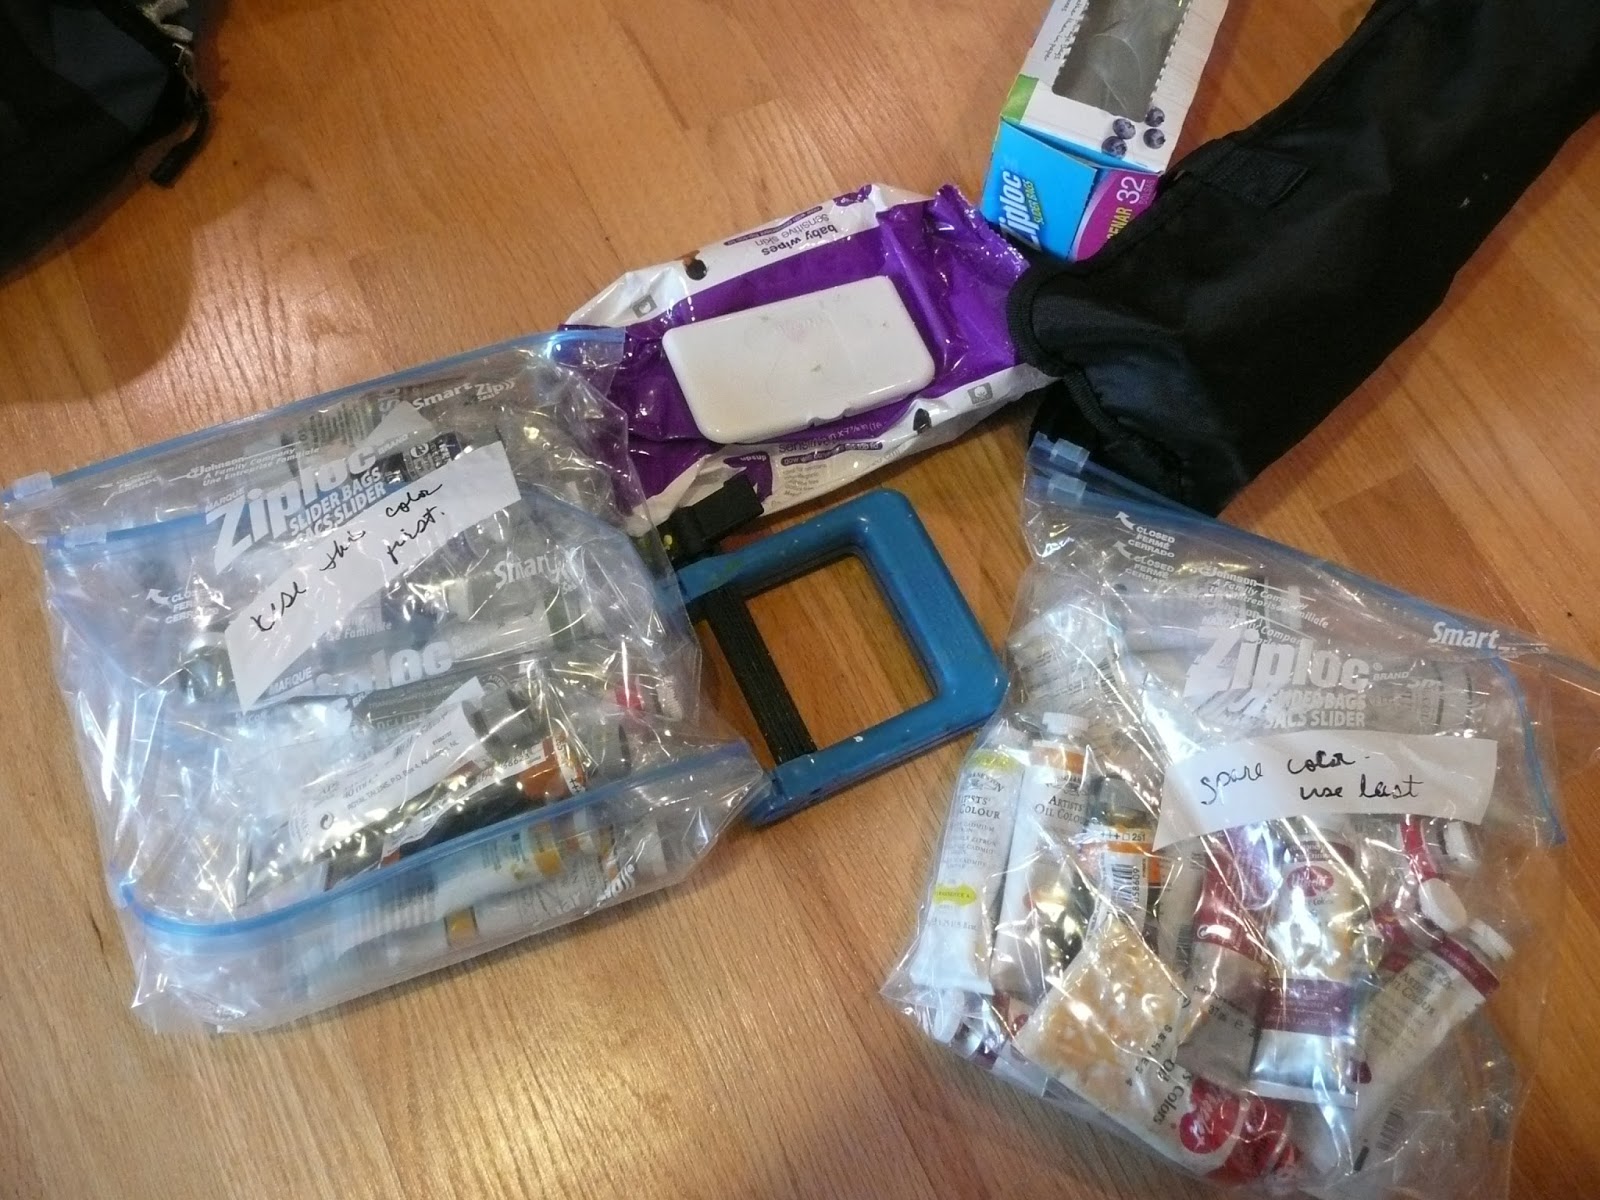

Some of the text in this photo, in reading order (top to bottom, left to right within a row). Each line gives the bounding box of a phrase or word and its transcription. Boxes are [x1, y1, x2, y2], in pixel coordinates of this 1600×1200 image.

[1022, 179, 1044, 225] SLIDER BAGS
[1117, 176, 1146, 204] 32
[780, 212, 829, 239] sensitive
[801, 222, 838, 245] baby
[755, 231, 782, 247] skin
[760, 233, 802, 257] wipes
[412, 381, 472, 411] Smart
[474, 381, 505, 399] Zip
[203, 476, 218, 486] Une
[220, 463, 273, 484] Entreprise
[214, 462, 247, 477] Family
[250, 448, 296, 469] Company
[206, 446, 377, 575] Ziploc
[289, 466, 382, 537] SLIDER BAGS
[332, 484, 387, 532] SLIDER
[320, 530, 366, 571] this
[385, 484, 443, 518] color
[1136, 526, 1176, 543] CLOSED
[1127, 539, 1175, 558] CERRADO
[1136, 532, 1170, 550] FERMÉ
[1134, 555, 1175, 572] CLOSED
[1212, 568, 1258, 586] Johnson
[1212, 578, 1221, 586] A
[1223, 581, 1257, 596] Family
[1428, 621, 1500, 651] Smart
[1182, 627, 1409, 698] Ziploc BRAND
[1310, 709, 1365, 728] SLIDER
[1287, 750, 1356, 775] color
[1299, 783, 1344, 801] use
[958, 804, 1001, 820] COLOUR
[1034, 803, 1055, 817] OIL
[1132, 832, 1146, 842] 251
[1156, 1058, 1175, 1082] Oil
[1153, 1085, 1185, 1126] Colors
